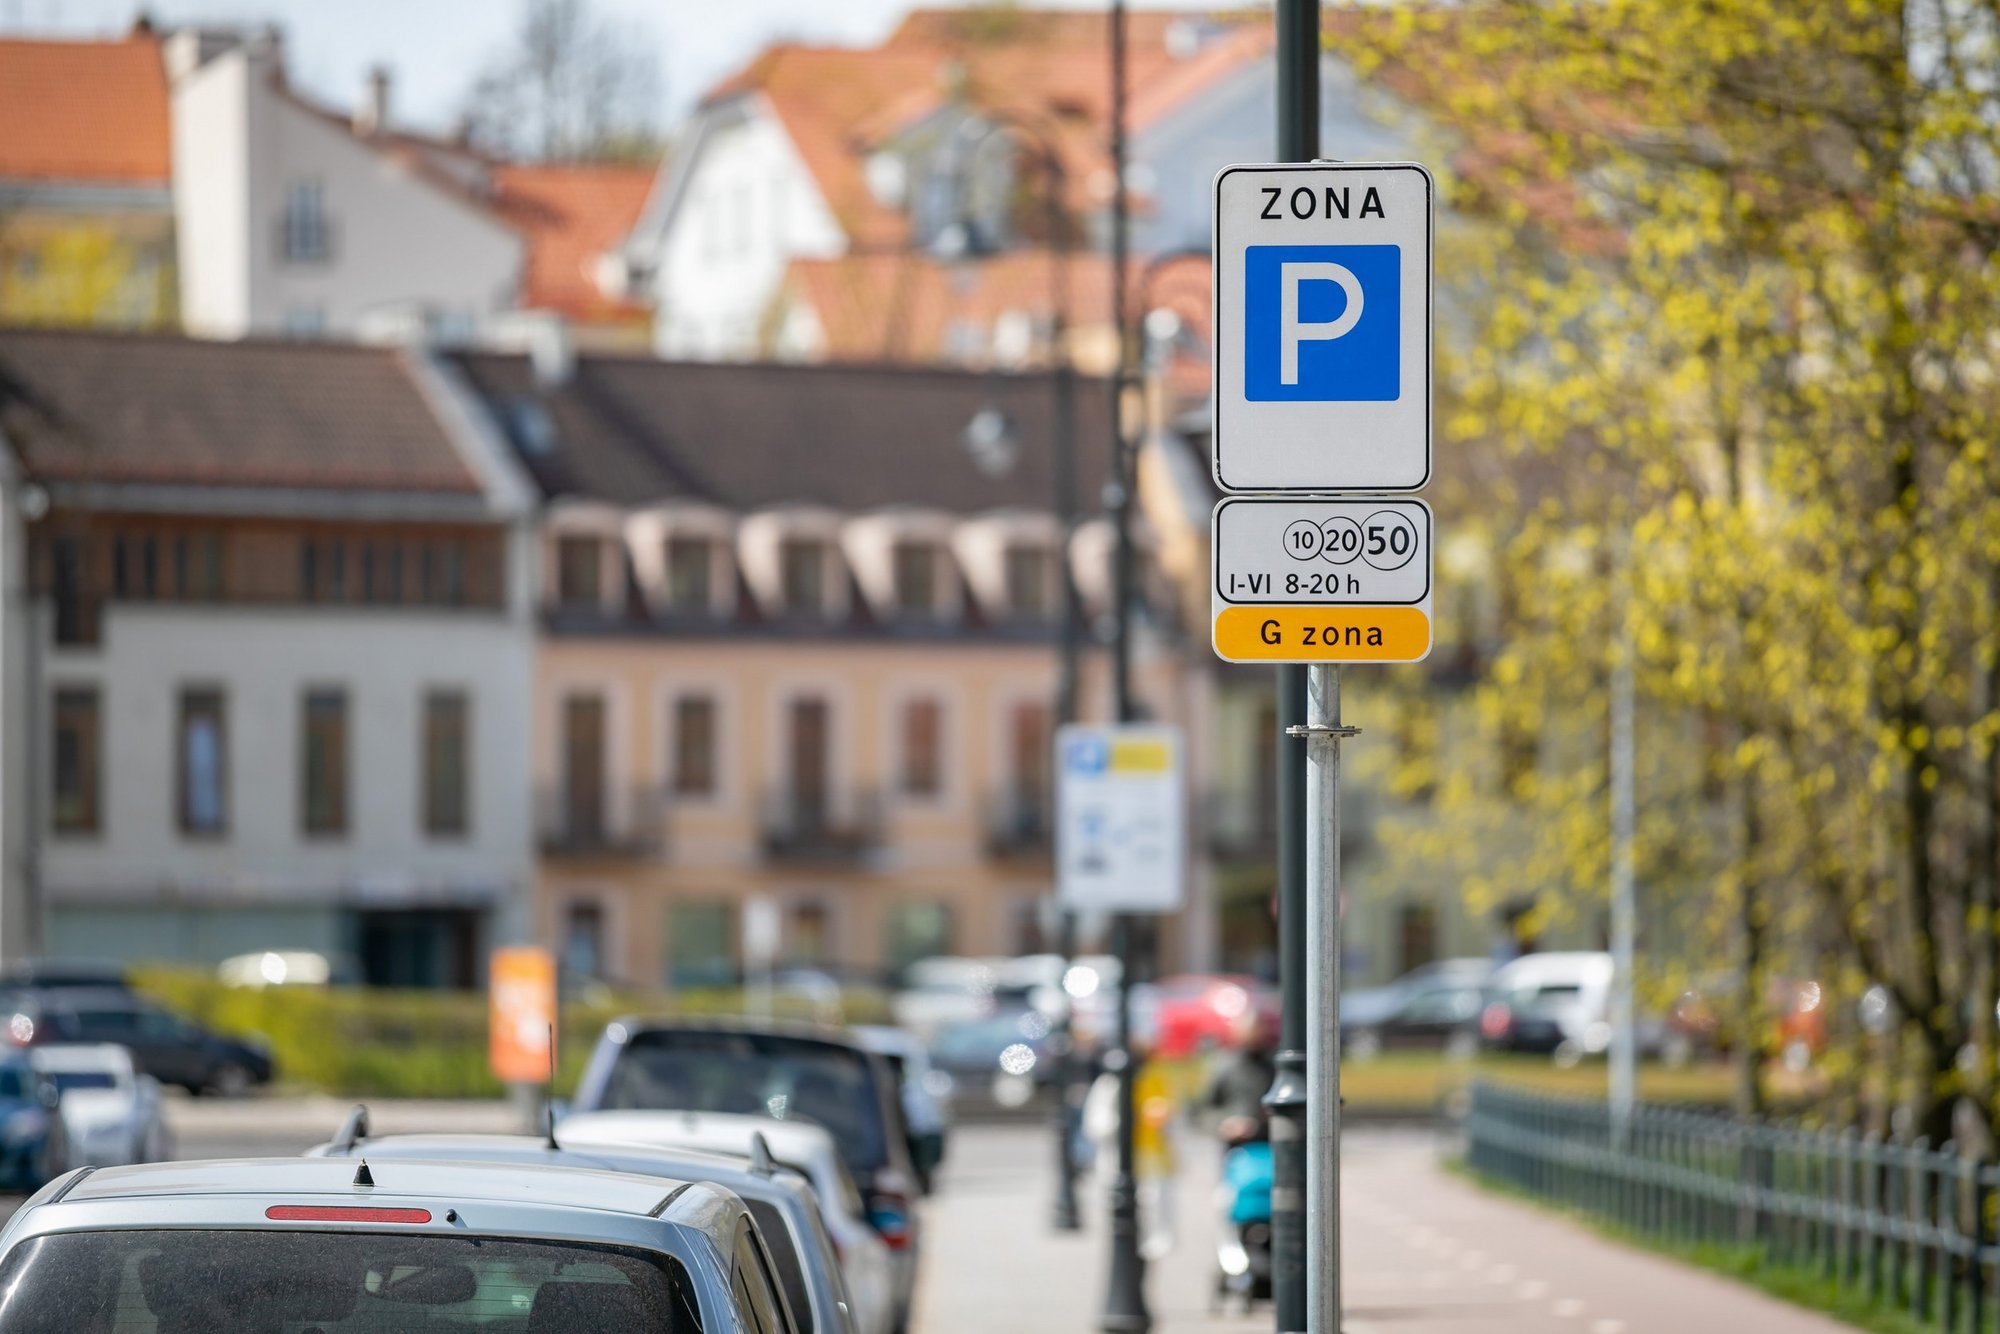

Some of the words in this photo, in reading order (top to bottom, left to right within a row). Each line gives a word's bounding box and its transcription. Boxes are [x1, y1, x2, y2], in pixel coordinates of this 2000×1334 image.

[1260, 186, 1386, 220] ZONA
[1280, 261, 1365, 385] P
[1292, 530, 1314, 550] 10
[1325, 529, 1357, 552] 20
[1367, 525, 1410, 555] 50
[1230, 573, 1271, 594] I-VI
[1285, 573, 1340, 595] 8-20
[1347, 573, 1360, 594] h
[1260, 619, 1282, 645] G
[1302, 626, 1383, 646] zona
